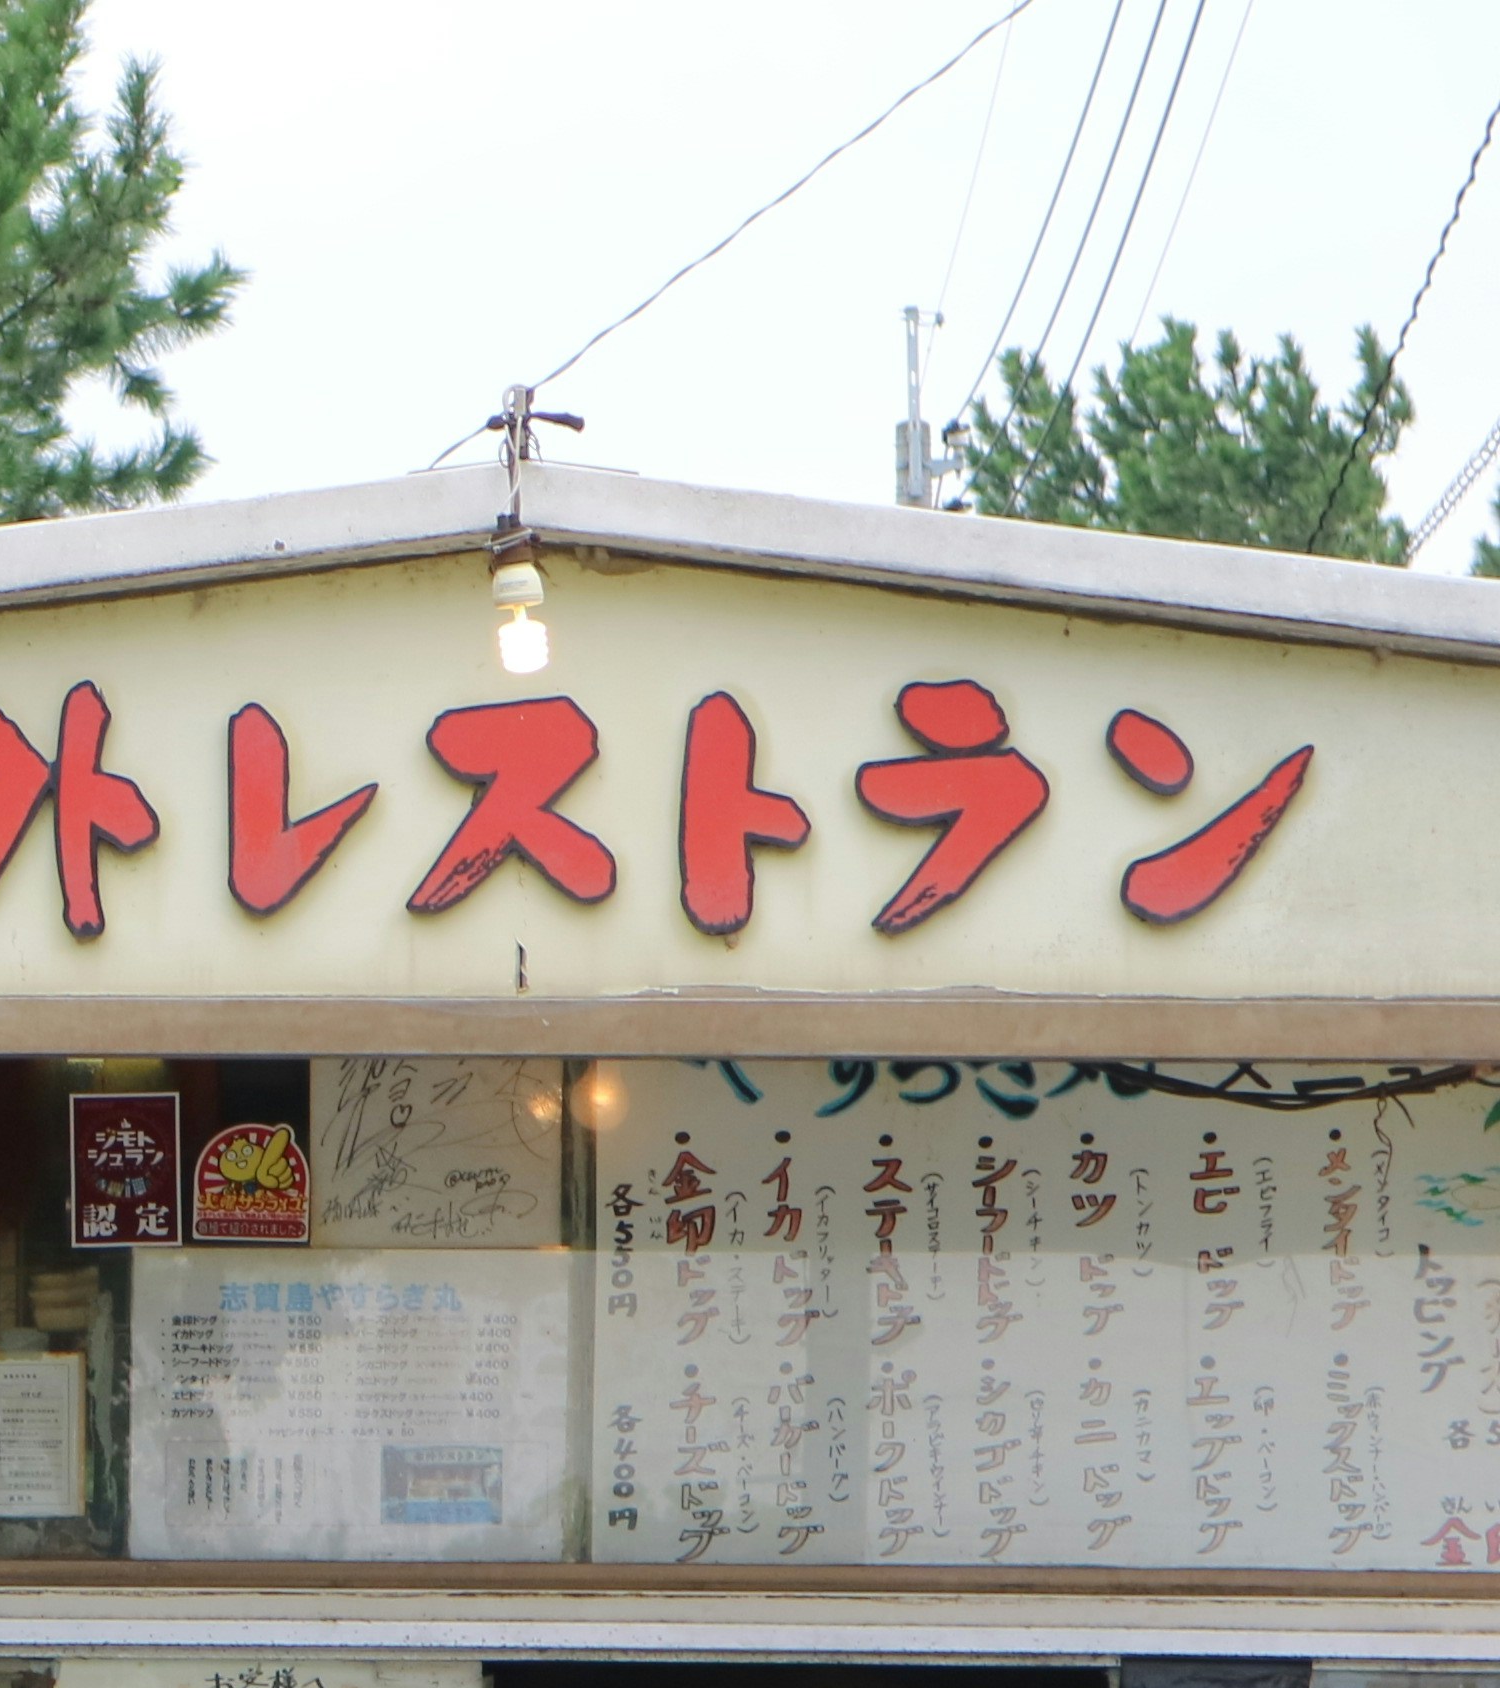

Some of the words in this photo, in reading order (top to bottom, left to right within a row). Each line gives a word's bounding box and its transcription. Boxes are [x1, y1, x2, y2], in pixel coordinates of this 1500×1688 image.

[87, 1149, 164, 1167] シュラン
[95, 1126, 155, 1150] ジモト
[218, 1281, 463, 1312] 志賀島やすらぎ丸
[661, 1151, 720, 1345] 金印ドッグ
[761, 1156, 820, 1347] イカドッグ
[1413, 1243, 1466, 1393] トッピング
[607, 1405, 643, 1530] 各400円
[669, 1382, 731, 1563] チーズドッグ
[767, 1374, 824, 1555] バーガードッグ
[866, 1369, 924, 1557] ポークドッグ
[974, 1375, 1027, 1558] シカゴドッグ
